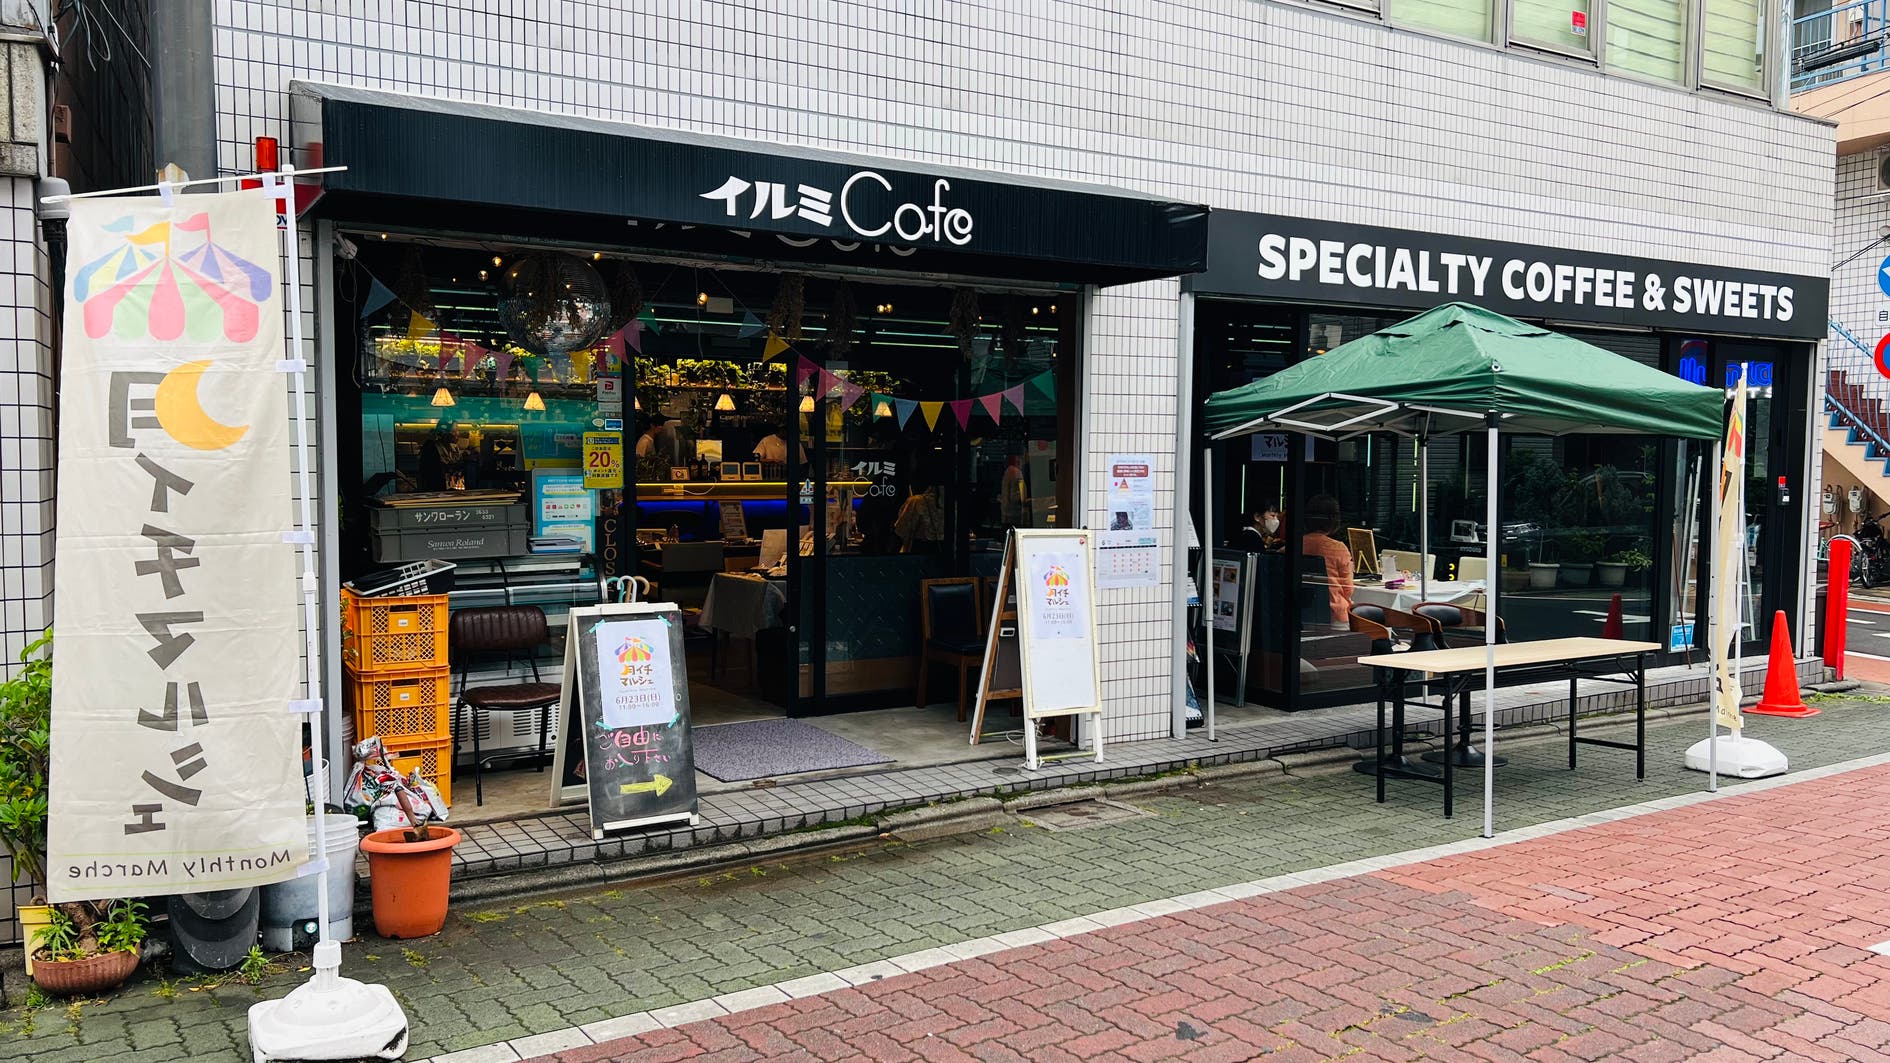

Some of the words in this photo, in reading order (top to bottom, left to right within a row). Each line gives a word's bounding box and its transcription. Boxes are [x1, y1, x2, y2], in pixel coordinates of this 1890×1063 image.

[699, 175, 833, 227] イルミ
[840, 170, 973, 245] Cafe
[1258, 233, 1493, 297] SPECIALTY
[1502, 259, 1635, 308] COFFEE
[1642, 273, 1666, 311] &
[1672, 276, 1795, 321] SWEETS
[850, 461, 896, 476] イルミ
[852, 476, 896, 497] Cafe
[415, 510, 470, 523] サンワローラン
[619, 676, 655, 687] マルシェ
